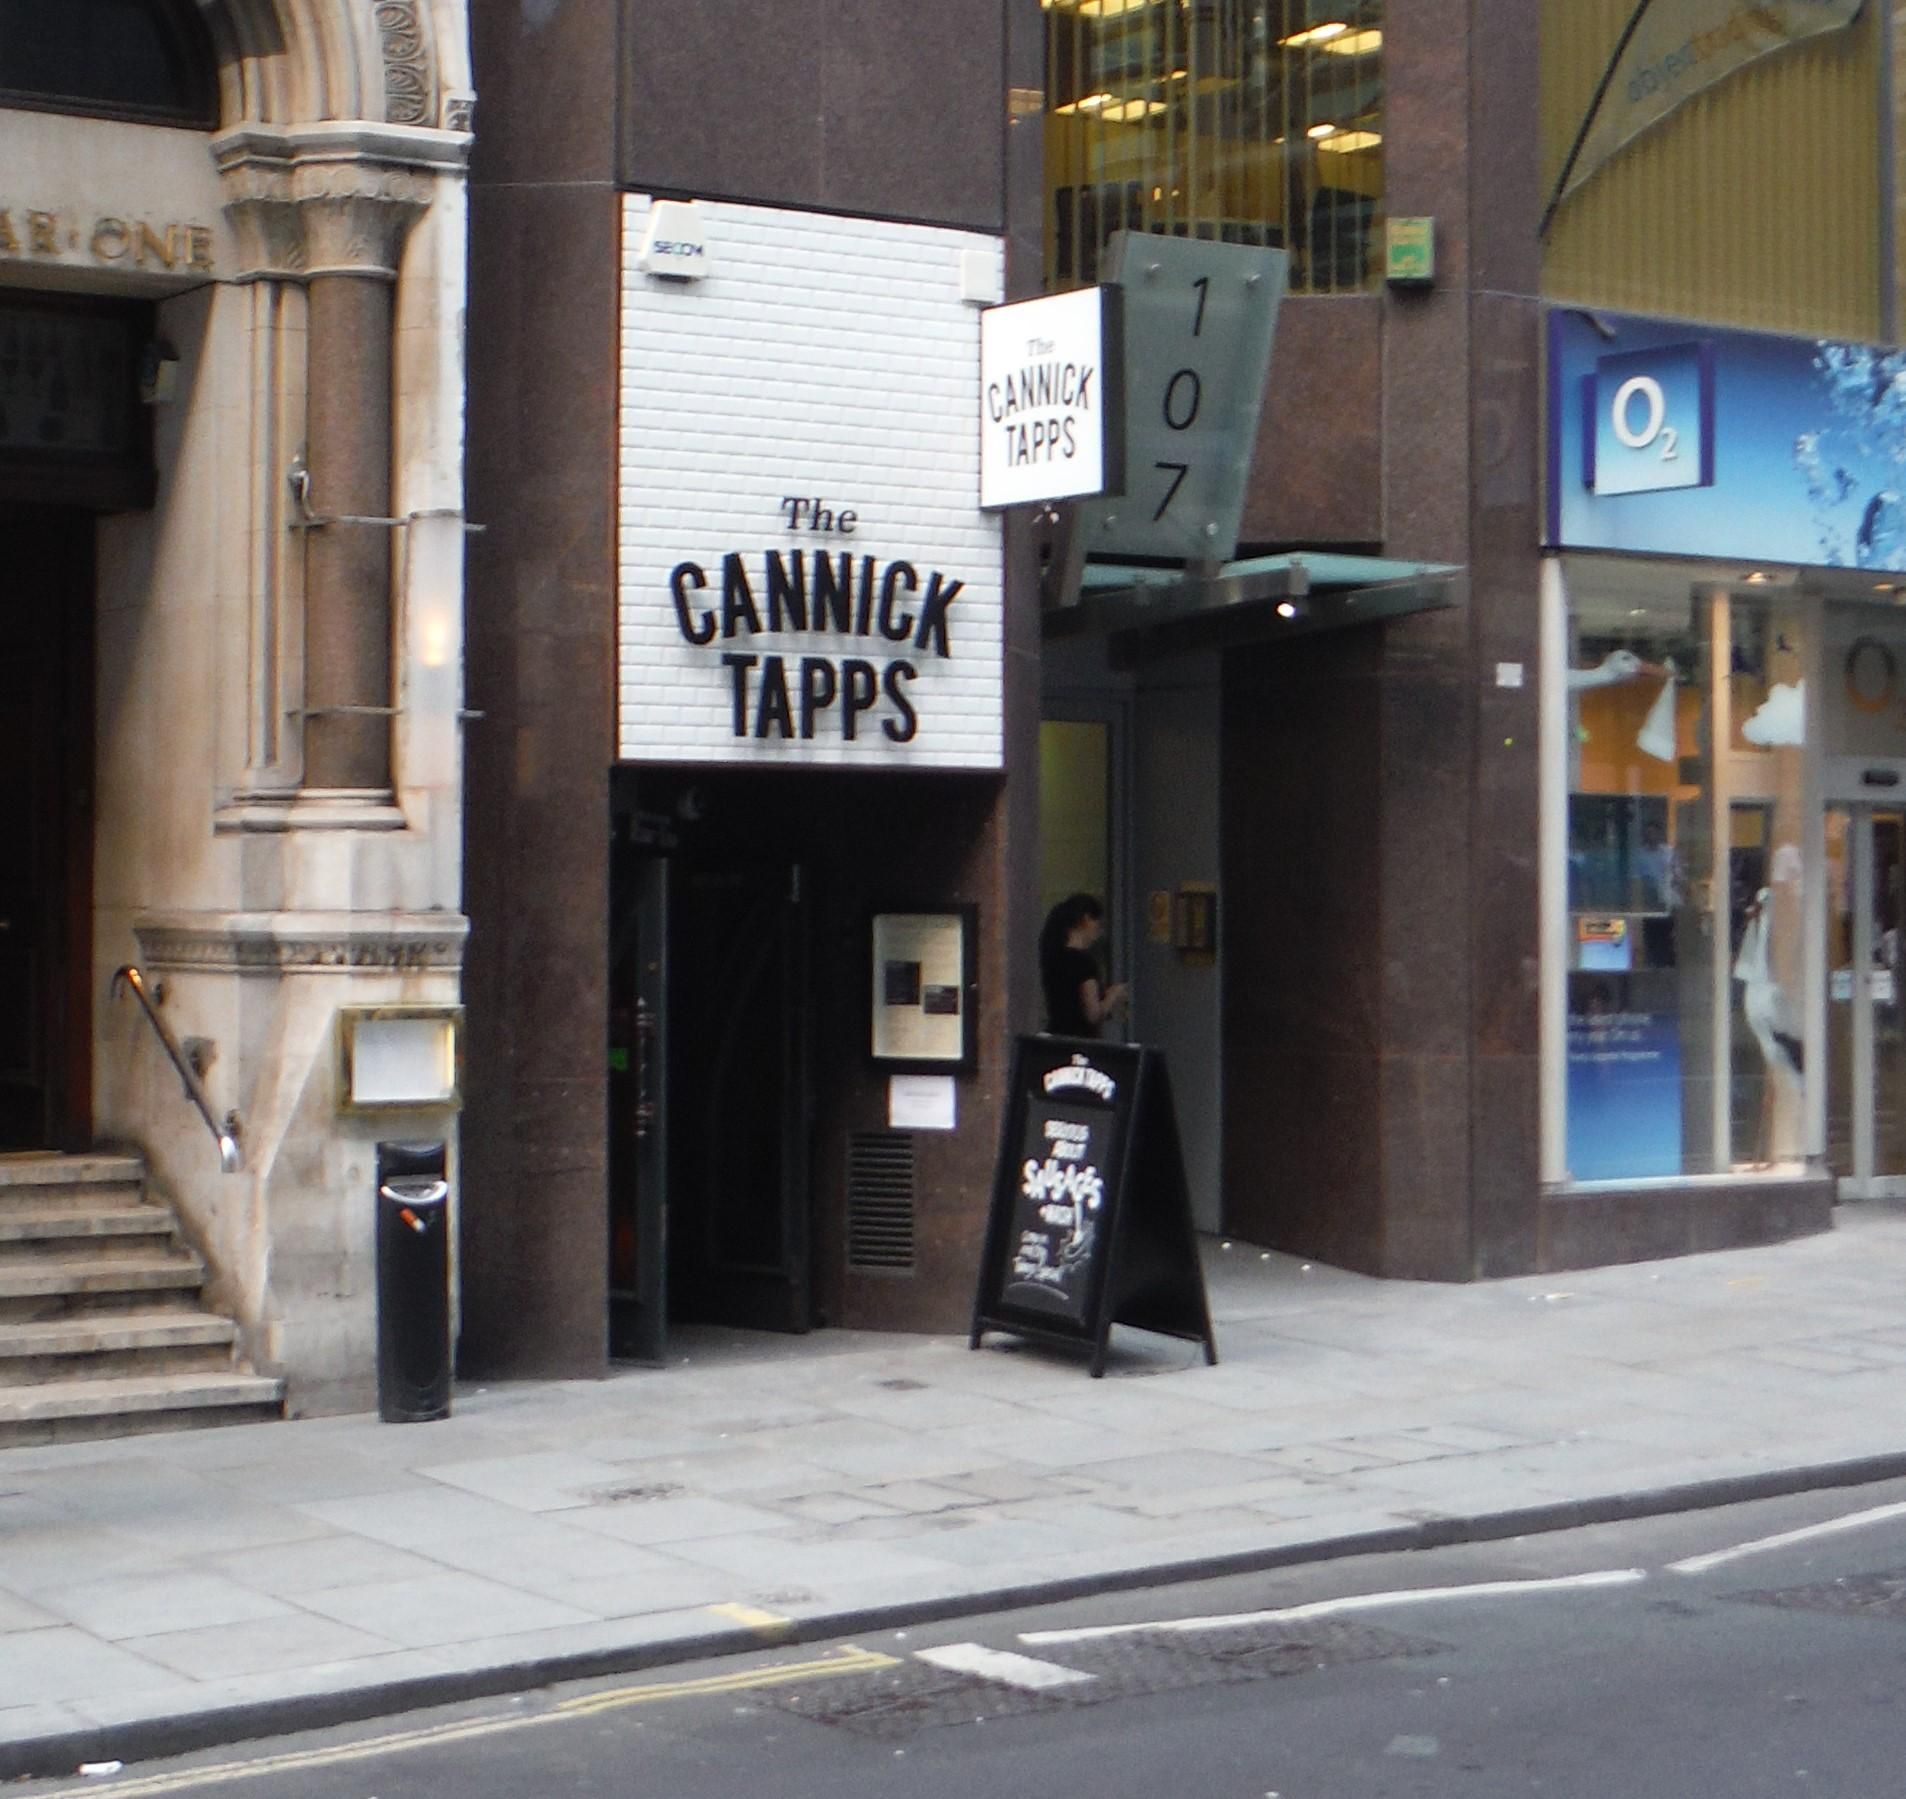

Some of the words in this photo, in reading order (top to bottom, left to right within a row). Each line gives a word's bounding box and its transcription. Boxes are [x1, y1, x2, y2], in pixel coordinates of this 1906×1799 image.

[90, 216, 215, 271] ONE
[1026, 338, 1055, 356] The
[987, 362, 1095, 423] CANNICK
[1005, 416, 1077, 467] TAPPS
[781, 496, 858, 534] The
[670, 547, 966, 659] CANNICK
[722, 653, 919, 743] TAPPS
